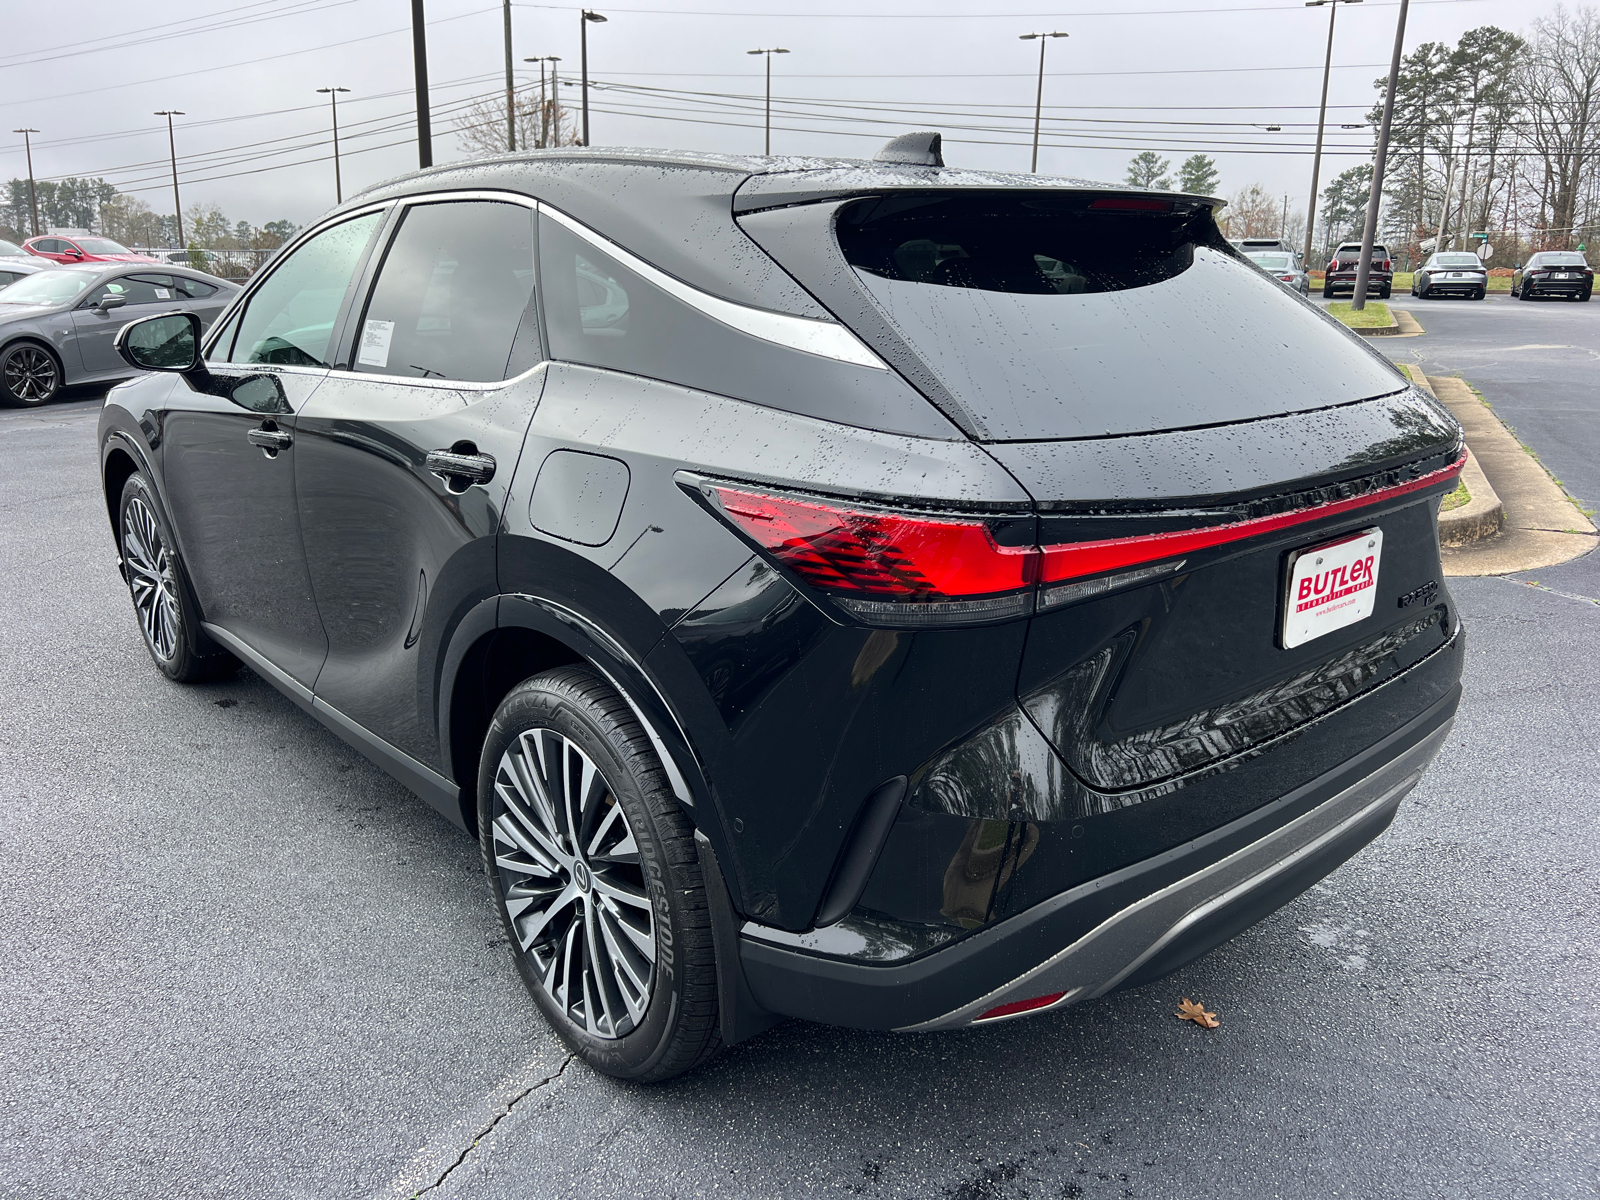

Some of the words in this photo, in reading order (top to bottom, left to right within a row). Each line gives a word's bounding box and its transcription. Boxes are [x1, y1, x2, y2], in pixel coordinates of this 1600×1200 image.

[1296, 589, 1346, 612] AUTOMOTIVE
[1351, 579, 1373, 592] GROUP
[623, 788, 675, 982] BRIDGESTONE
